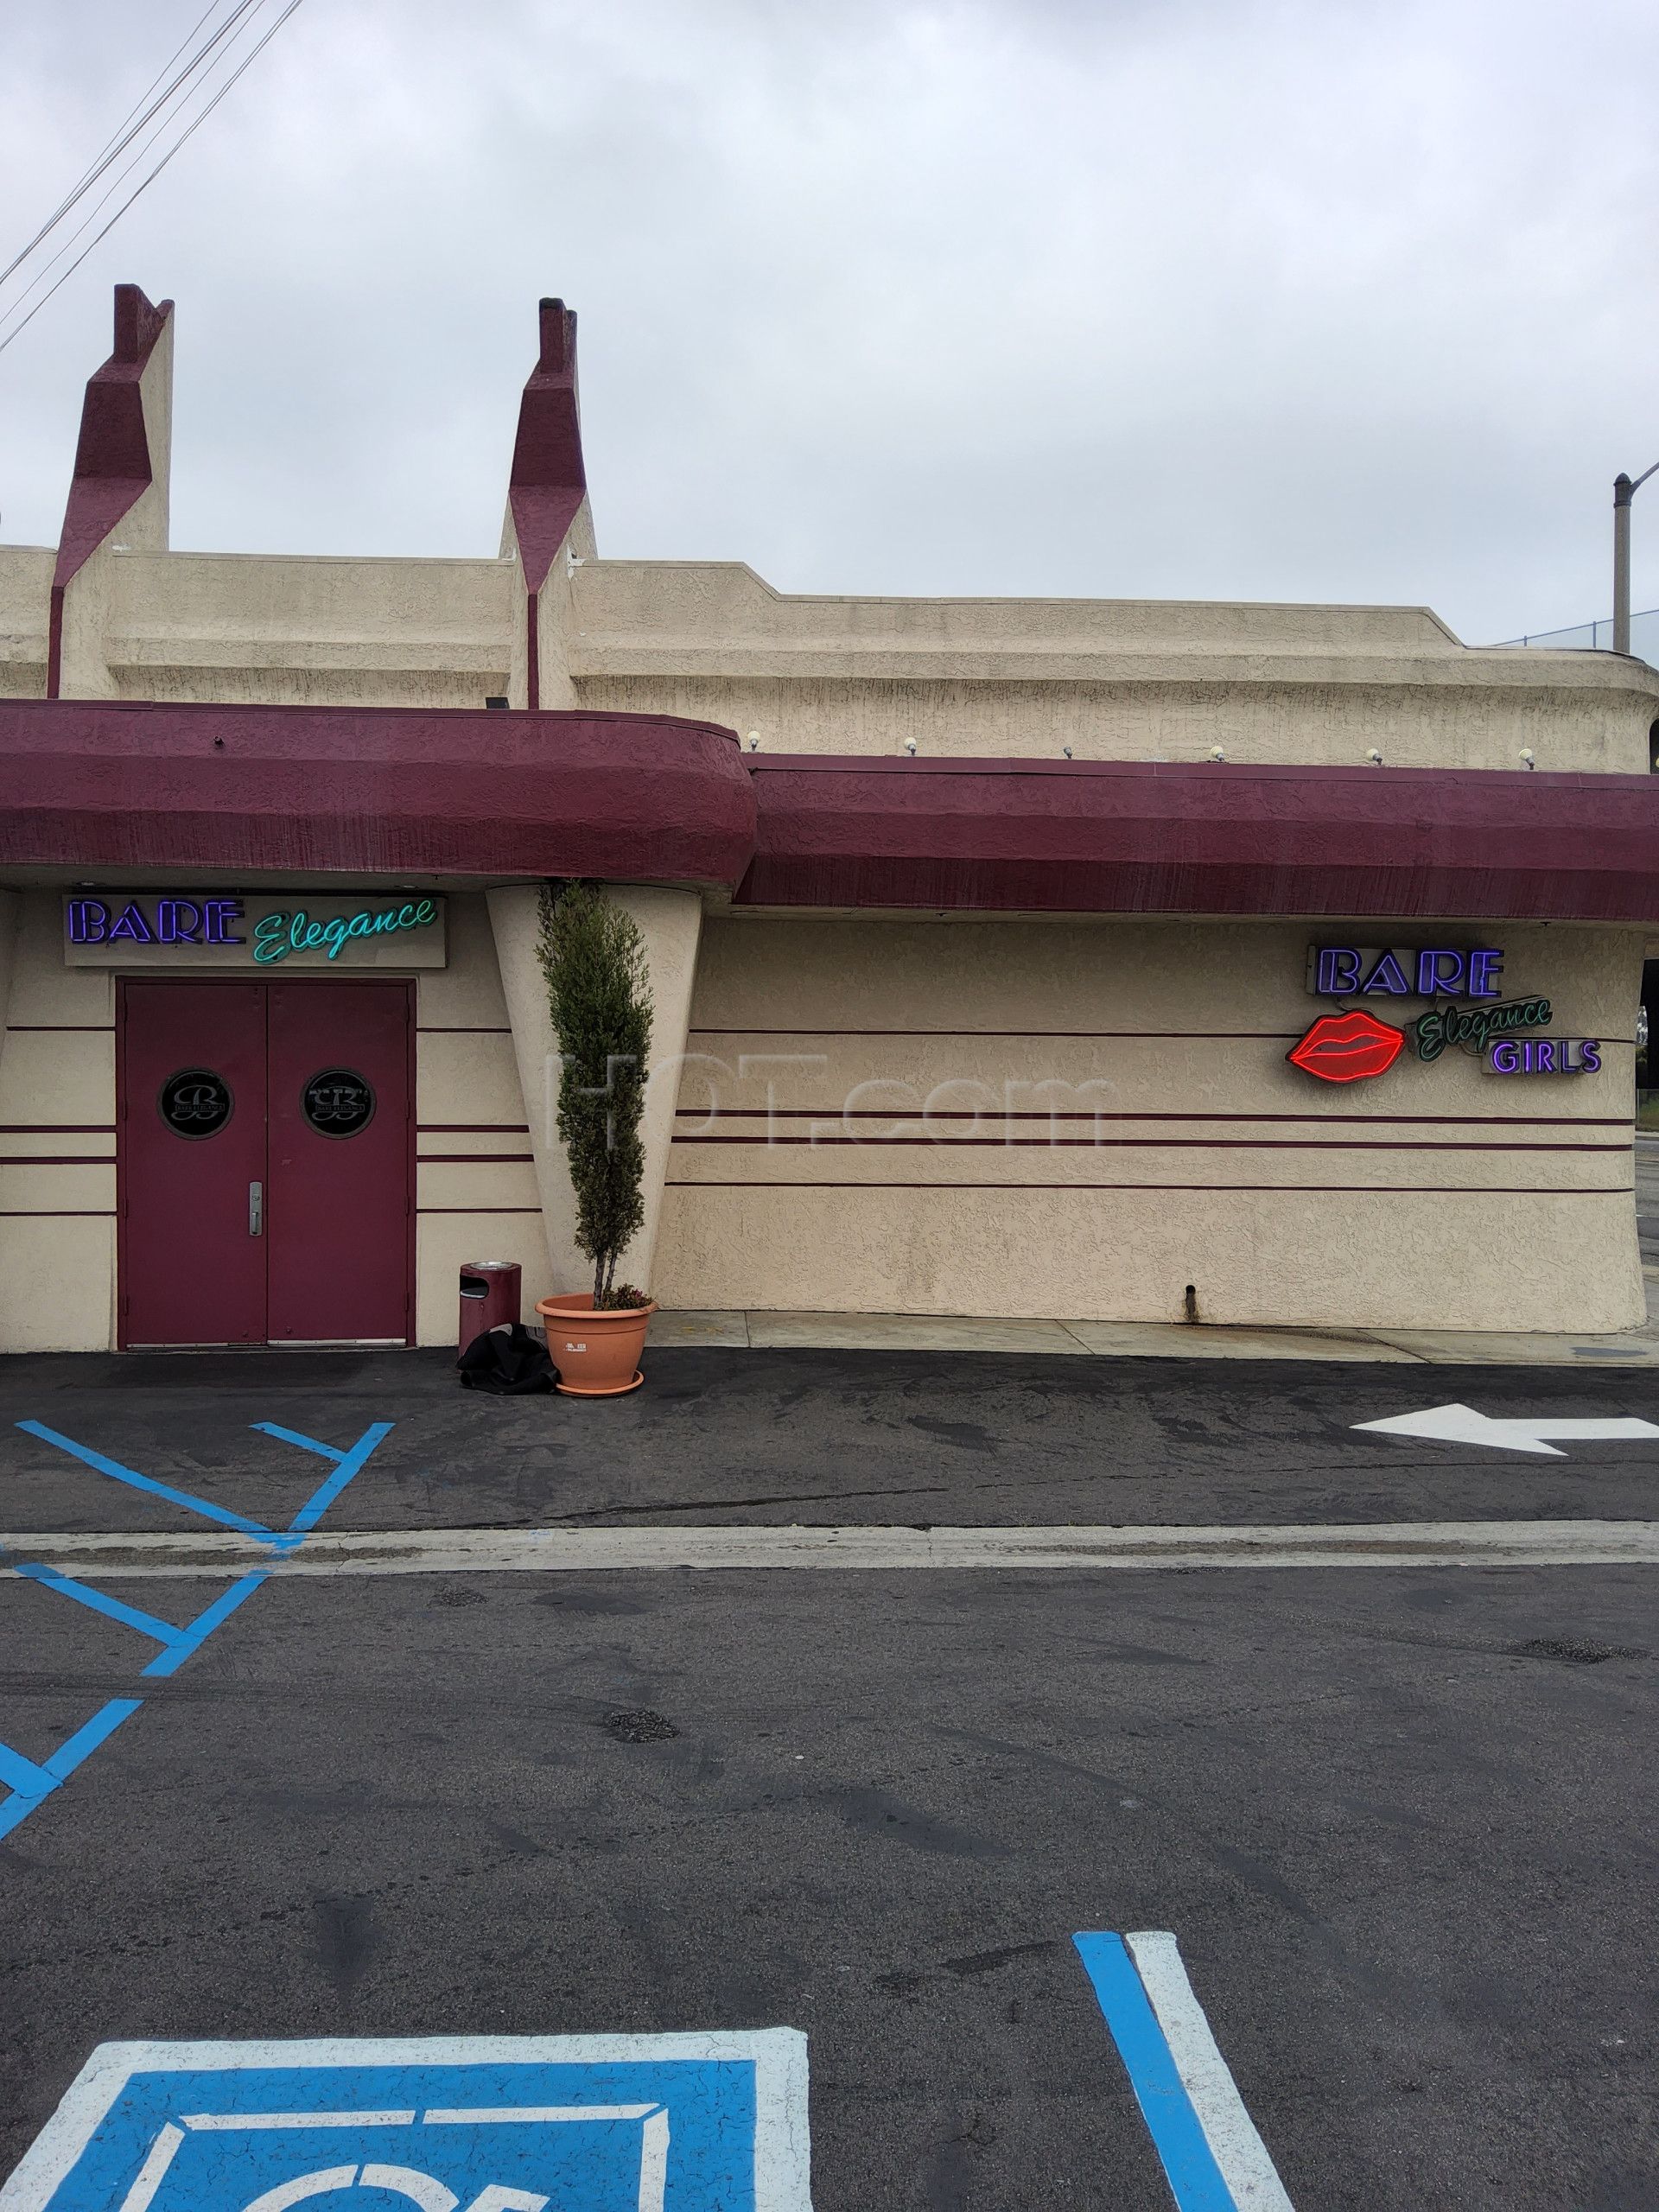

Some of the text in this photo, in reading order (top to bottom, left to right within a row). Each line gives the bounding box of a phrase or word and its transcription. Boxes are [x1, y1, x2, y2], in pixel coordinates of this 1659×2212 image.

[68, 898, 436, 965] BARE Elegance
[1316, 948, 1504, 997] BARE
[1415, 998, 1554, 1063] Elegance
[1491, 1039, 1602, 1074] GIRLS
